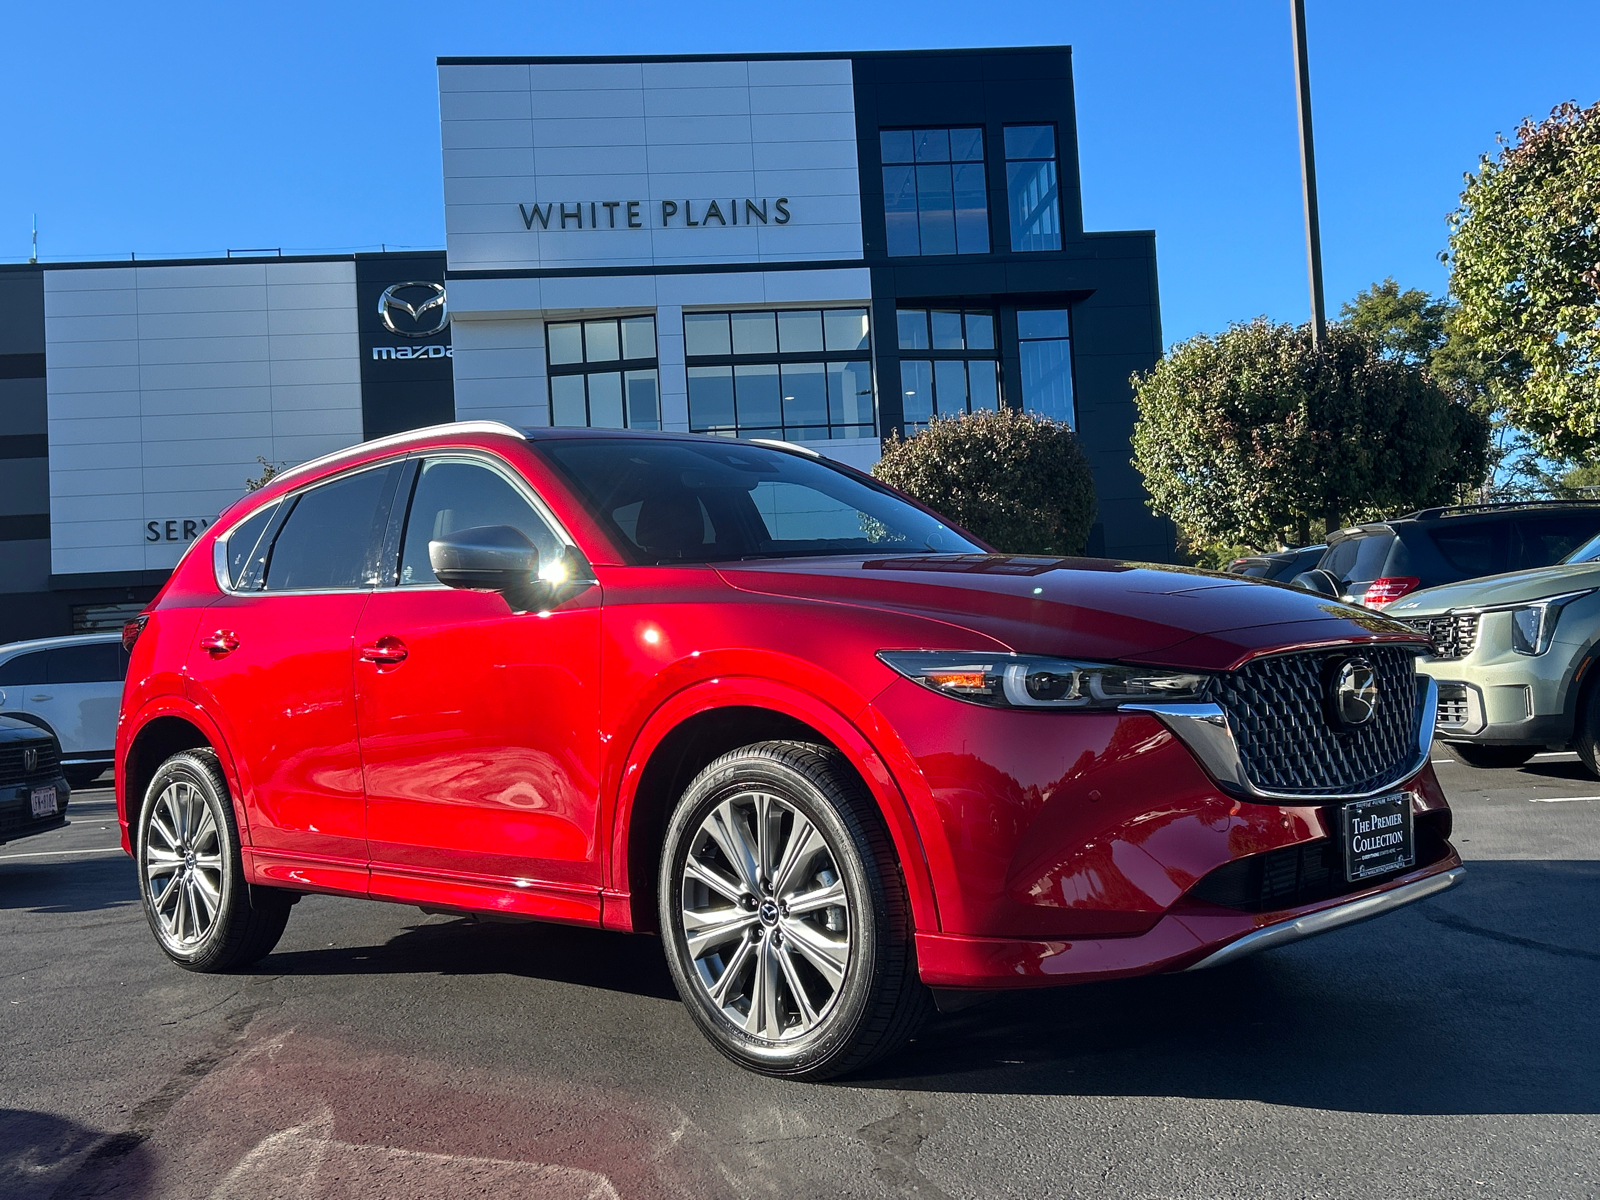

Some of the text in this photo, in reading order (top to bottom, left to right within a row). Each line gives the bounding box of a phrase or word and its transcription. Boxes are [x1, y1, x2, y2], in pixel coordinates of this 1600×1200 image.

[519, 197, 791, 230] WHITE PLAINS
[1352, 813, 1403, 835] THE PREMIER
[1353, 830, 1403, 853] COLLECTION
